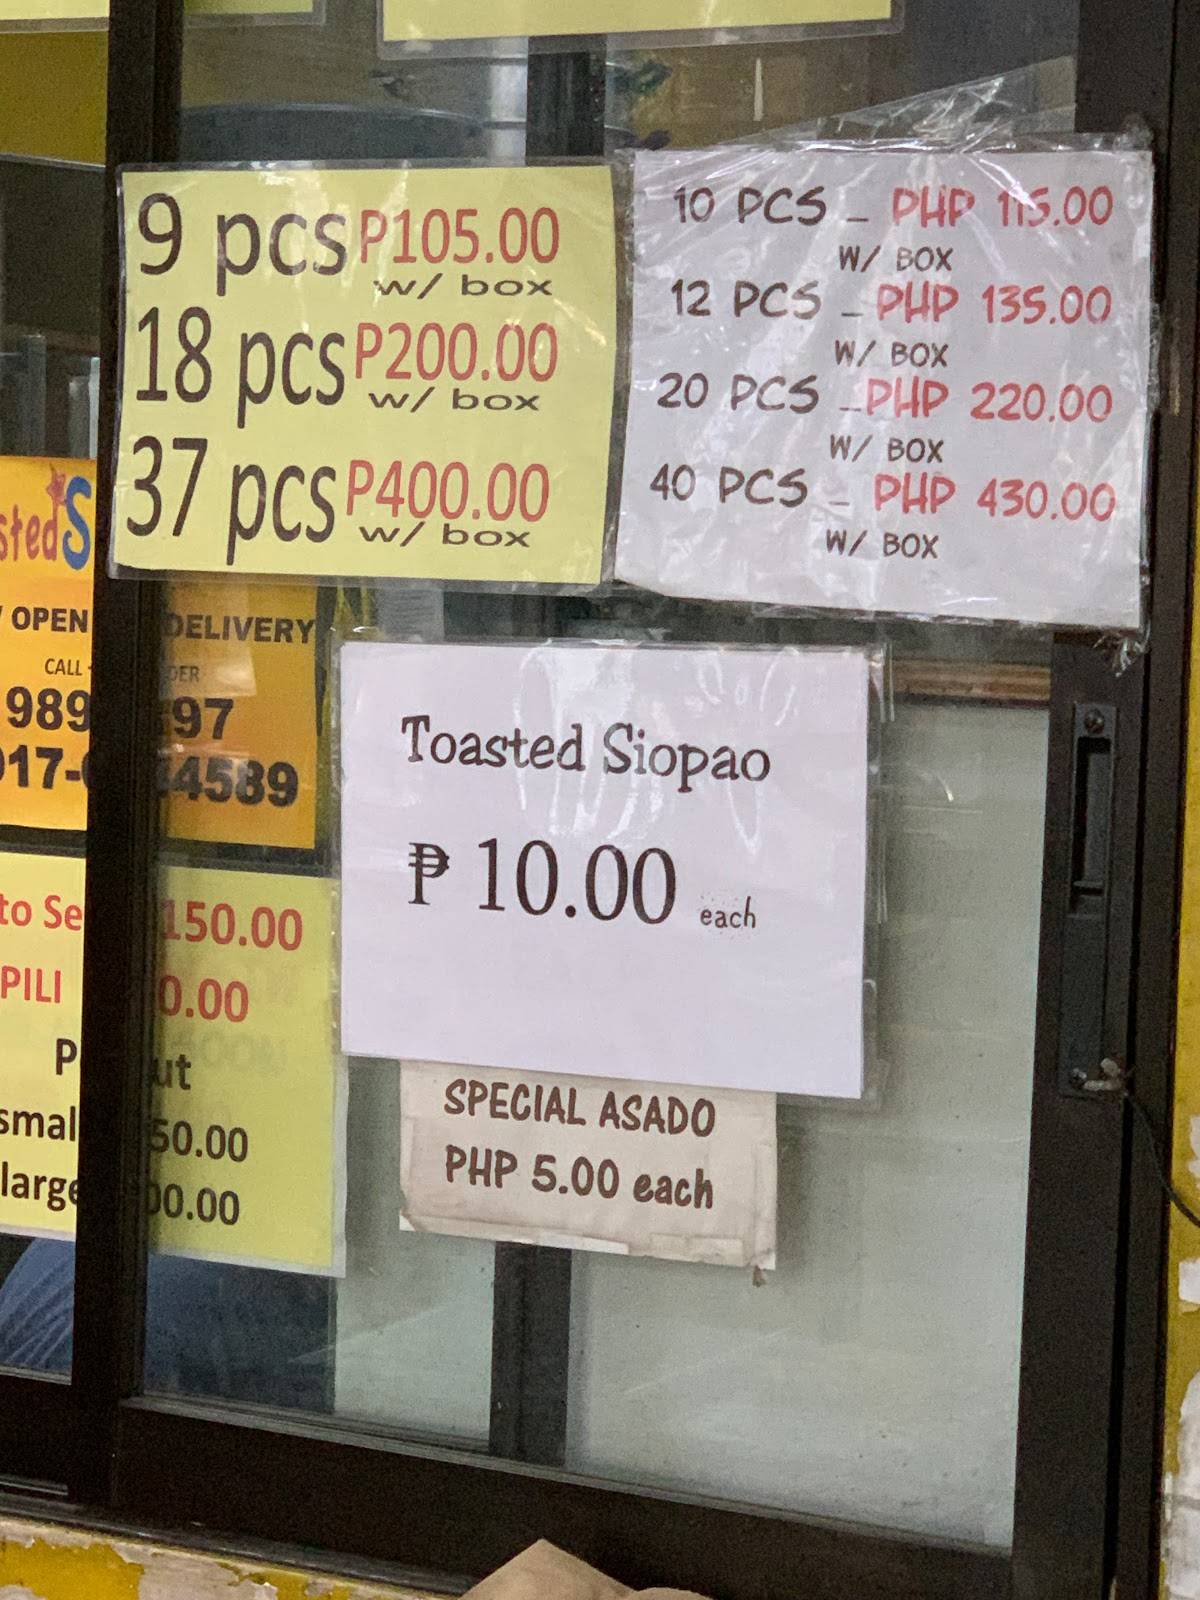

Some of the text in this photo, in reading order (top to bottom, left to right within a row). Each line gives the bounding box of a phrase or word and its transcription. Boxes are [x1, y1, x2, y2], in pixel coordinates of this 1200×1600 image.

[674, 188, 714, 222] 10
[738, 186, 826, 225] PCS
[893, 186, 975, 228] PHP
[997, 185, 1114, 228] 115.00
[138, 193, 560, 297] 9 pcs P105.00
[839, 246, 952, 272] W/ BOX
[374, 273, 553, 299] w/ box
[672, 279, 711, 317] 12
[734, 281, 822, 320] PCS
[877, 281, 960, 322] PHP
[982, 285, 1112, 324] 135.00
[136, 307, 558, 429] 18 pcs P200.00
[834, 340, 949, 368] W/ BOX
[368, 387, 540, 412] w/ box
[657, 373, 709, 408] 20
[731, 374, 819, 414] PCS
[866, 377, 949, 418] PHP
[970, 382, 1113, 422] 220.00
[830, 435, 944, 463] W/ BOX
[126, 436, 550, 566] 37 pcs P400.00
[650, 463, 695, 500] 40
[719, 468, 808, 507] PCS
[875, 472, 956, 513] PHP
[977, 479, 1116, 522] 430.00
[359, 522, 531, 548] w/ box
[825, 530, 939, 559] W/ BOX
[11, 606, 88, 633] OPEN
[162, 613, 315, 643] DELIVERY
[44, 658, 82, 676] CALL
[6, 687, 90, 732] 989
[401, 715, 771, 793] Toasted Siopao
[477, 838, 677, 924] 10.00
[700, 897, 757, 930] each
[163, 901, 303, 951] 150.00
[1, 966, 62, 1004] PILI
[444, 1079, 716, 1138] SPECIAL ASADO
[445, 1145, 713, 1209] PHP 5.00 each
